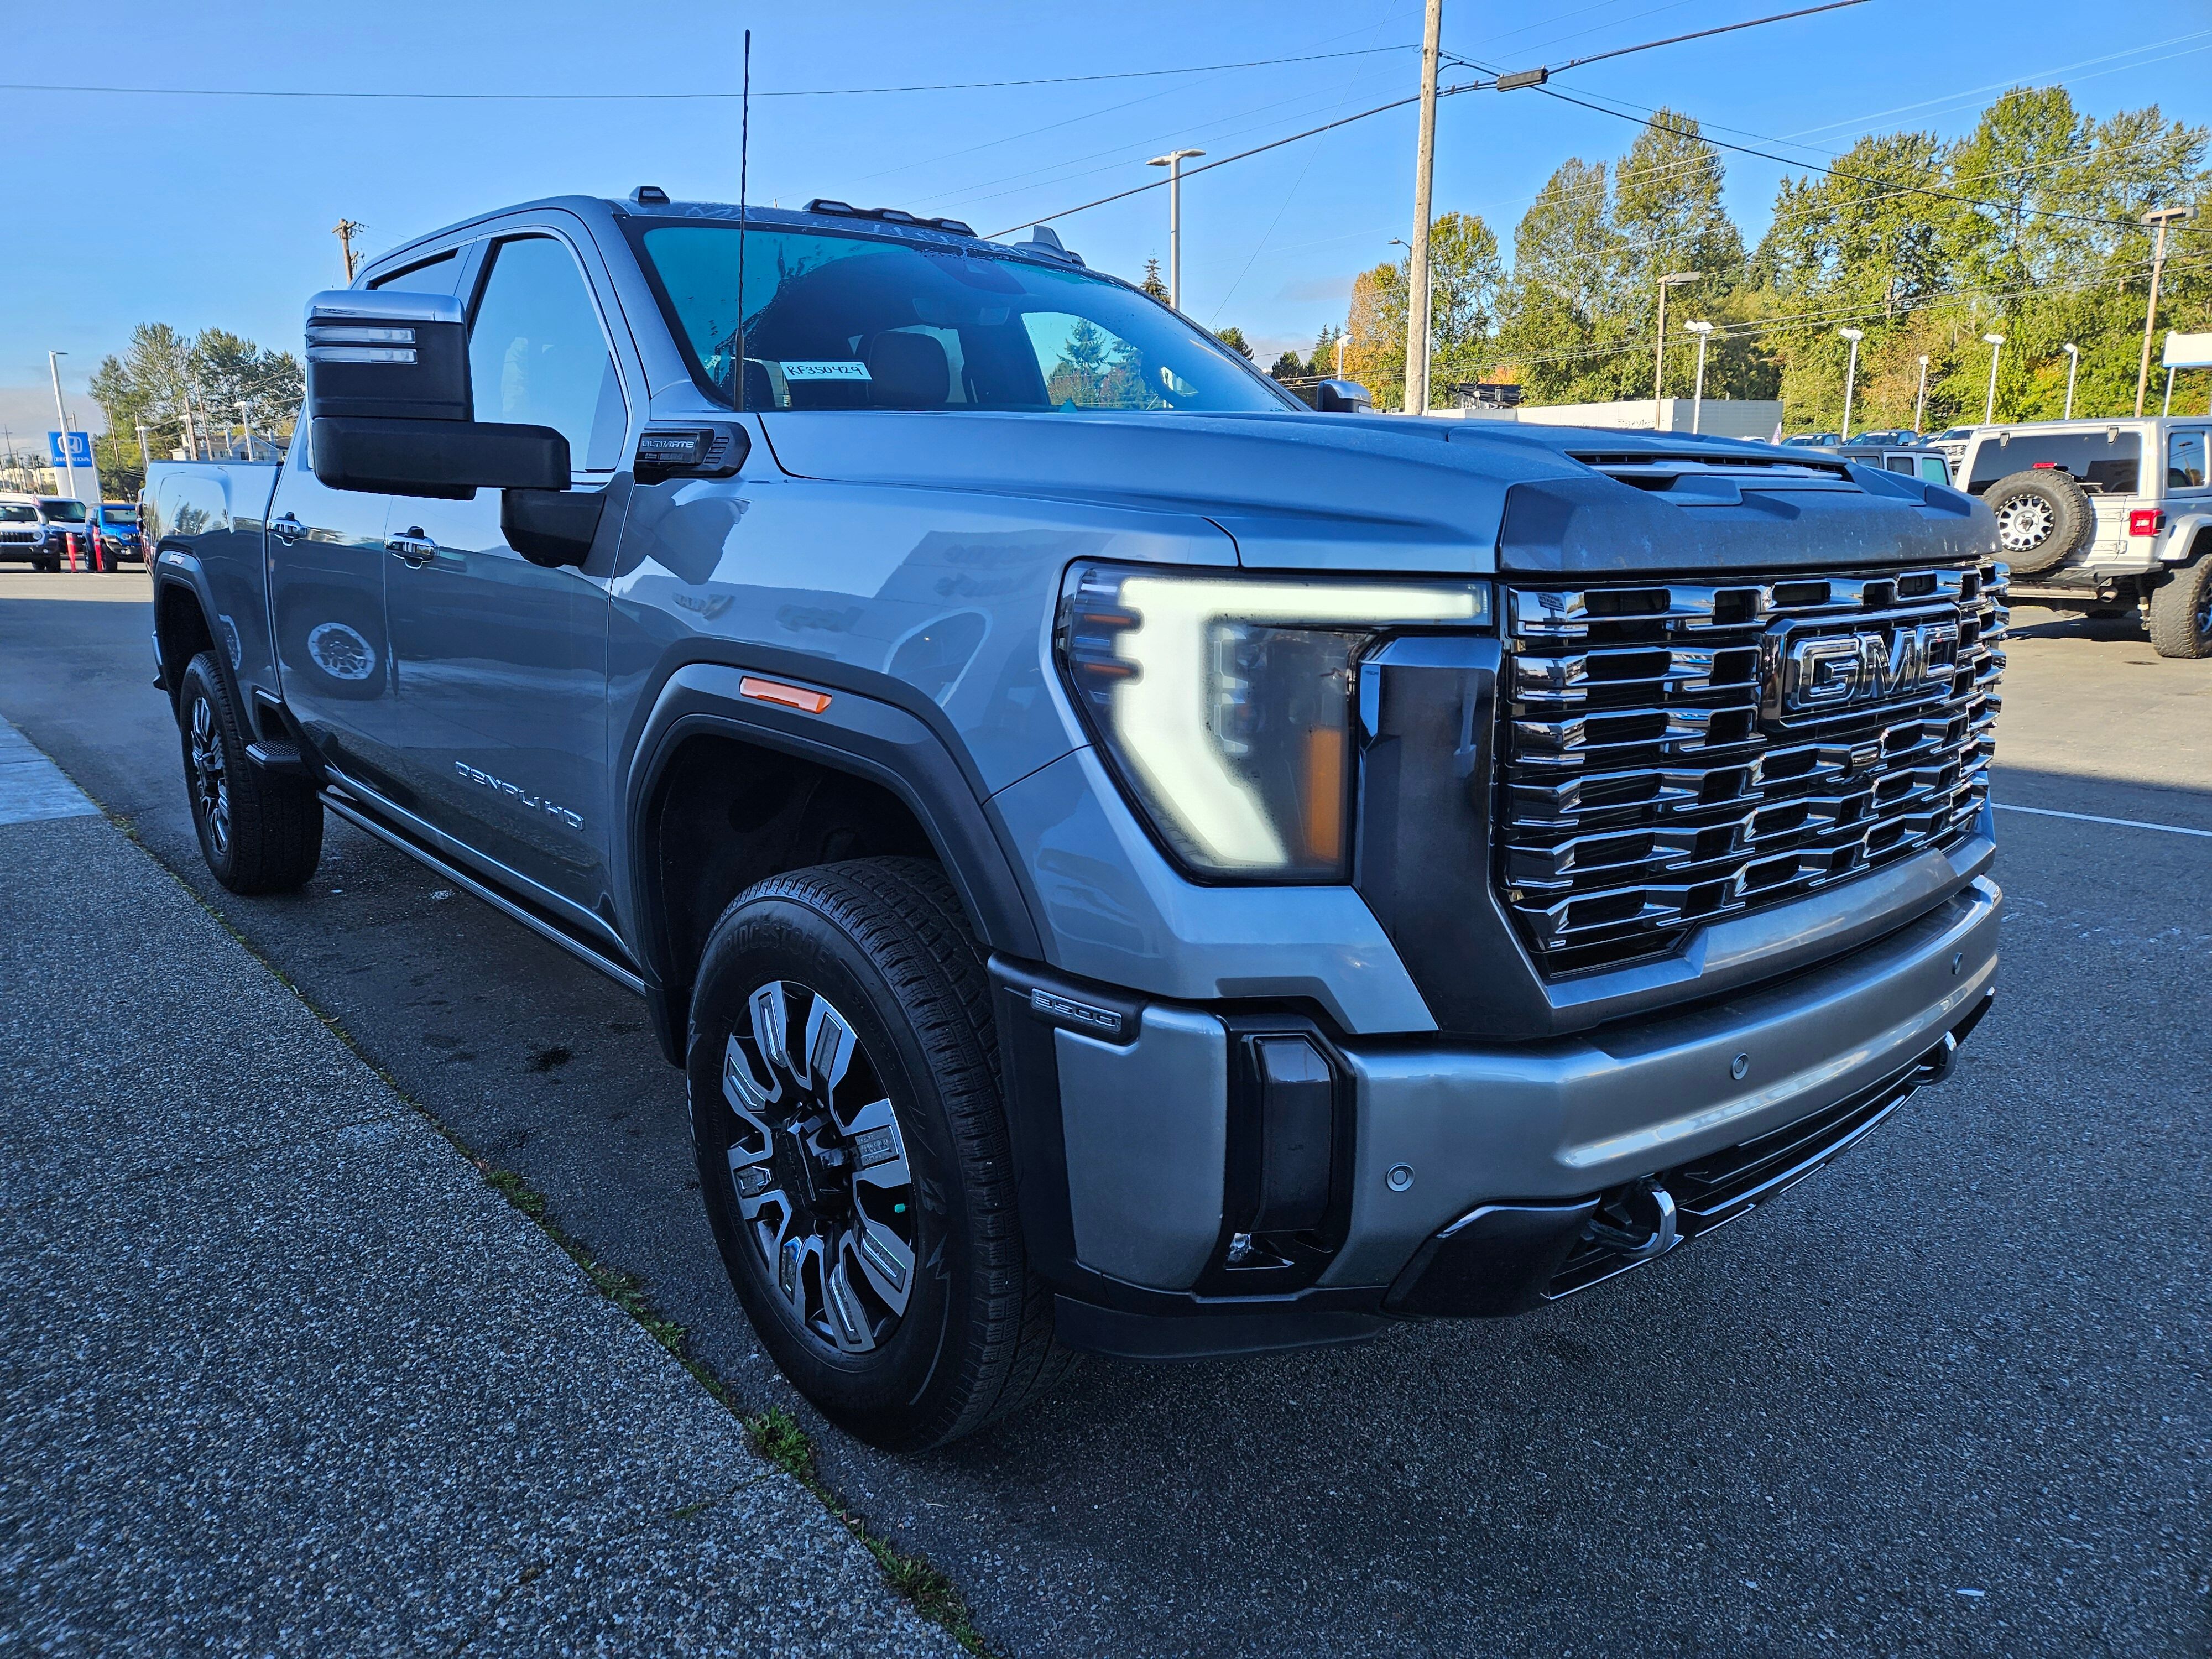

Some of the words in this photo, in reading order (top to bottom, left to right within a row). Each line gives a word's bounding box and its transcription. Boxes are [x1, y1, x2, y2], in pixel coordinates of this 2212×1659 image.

[786, 365, 863, 376] RF350429
[1616, 419, 1656, 427] Service
[642, 440, 695, 448] ULTIMATE
[1786, 623, 1958, 711] GMC
[455, 761, 541, 811] DENALI
[544, 801, 584, 830] HD
[1035, 994, 1116, 1027] 3500
